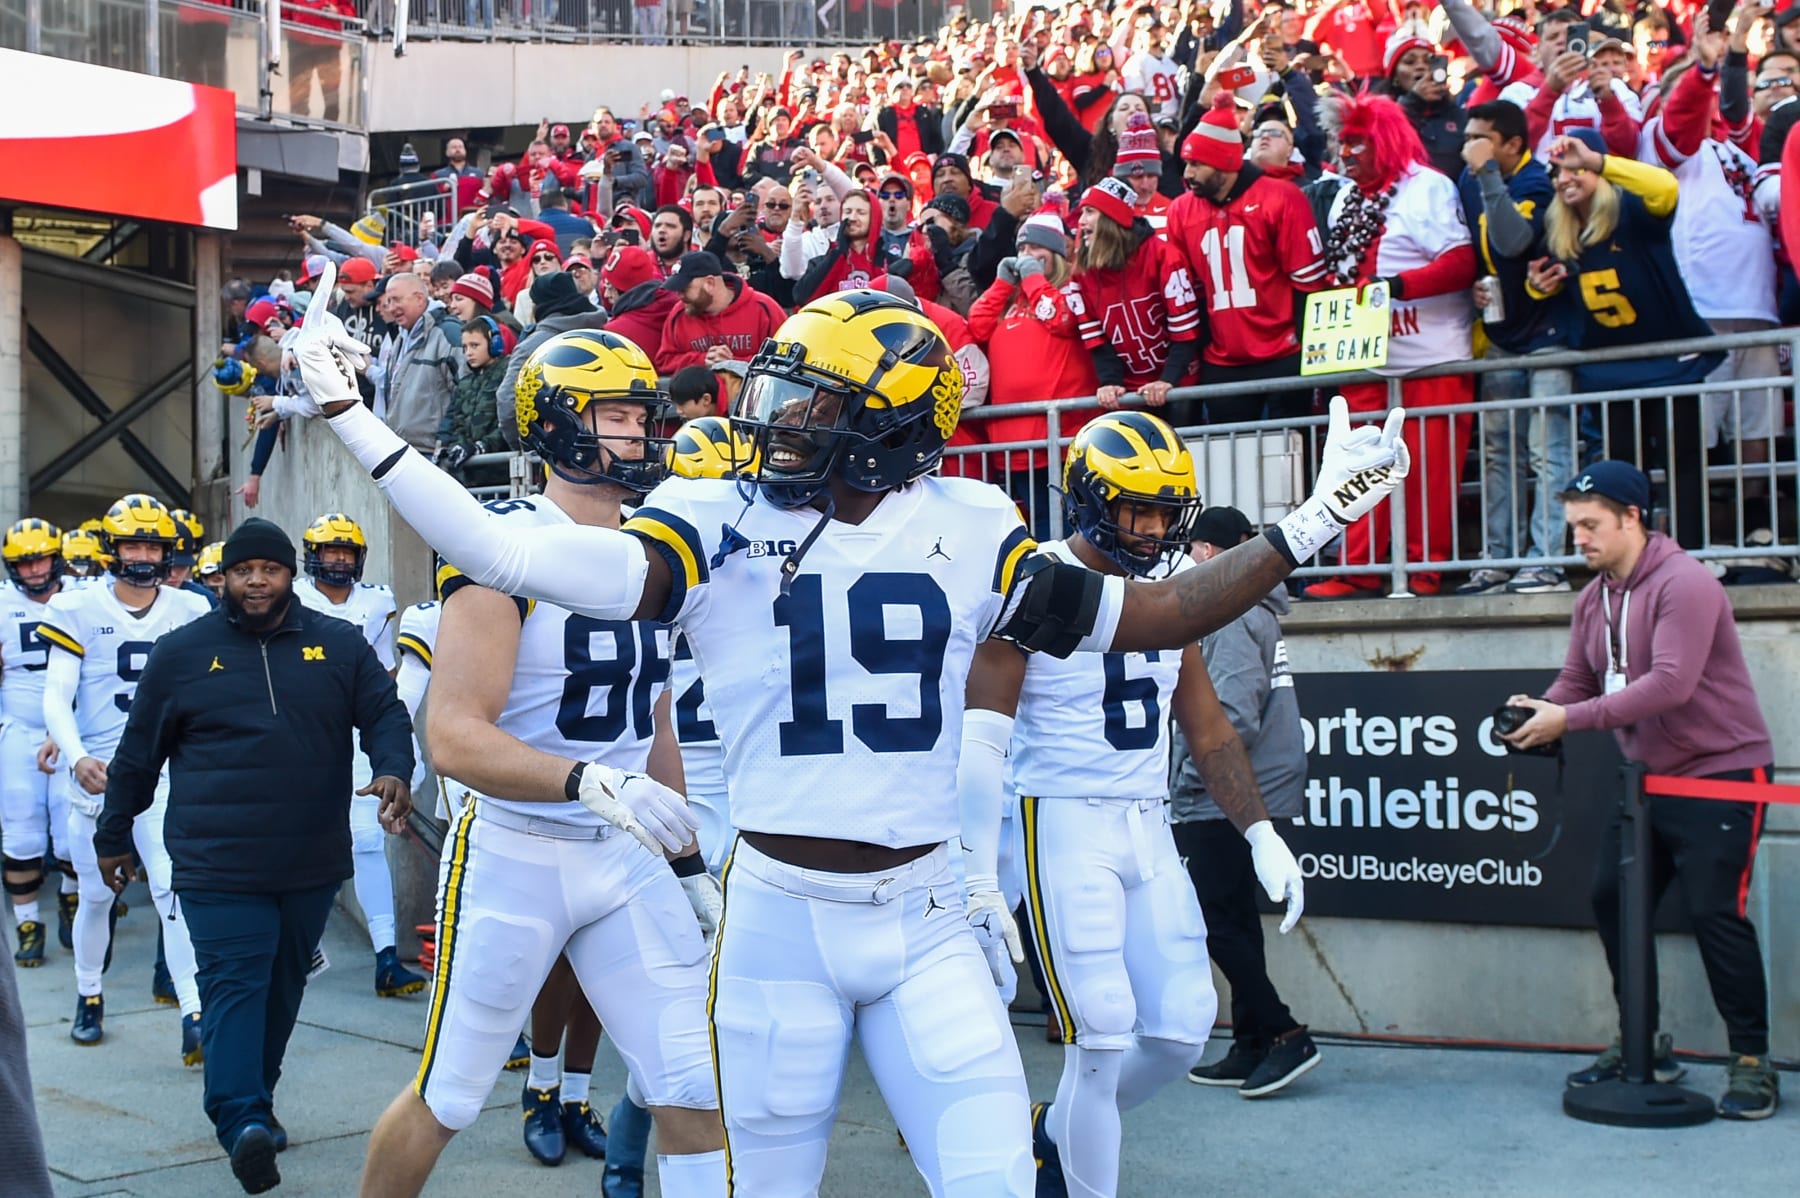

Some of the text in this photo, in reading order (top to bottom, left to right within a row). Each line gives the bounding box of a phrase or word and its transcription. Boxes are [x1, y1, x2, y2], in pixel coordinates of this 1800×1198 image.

[1201, 225, 1257, 311] 11
[1580, 268, 1637, 328] 5
[1102, 291, 1171, 374] 45
[1314, 298, 1353, 324] THE
[1336, 335, 1382, 361] GAME
[114, 641, 157, 713] 9
[302, 645, 327, 661] M
[773, 572, 952, 757] 19
[1102, 650, 1161, 751] 6
[1293, 777, 1540, 833] thletics
[1298, 853, 1543, 890] OSUBuckeyeClub
